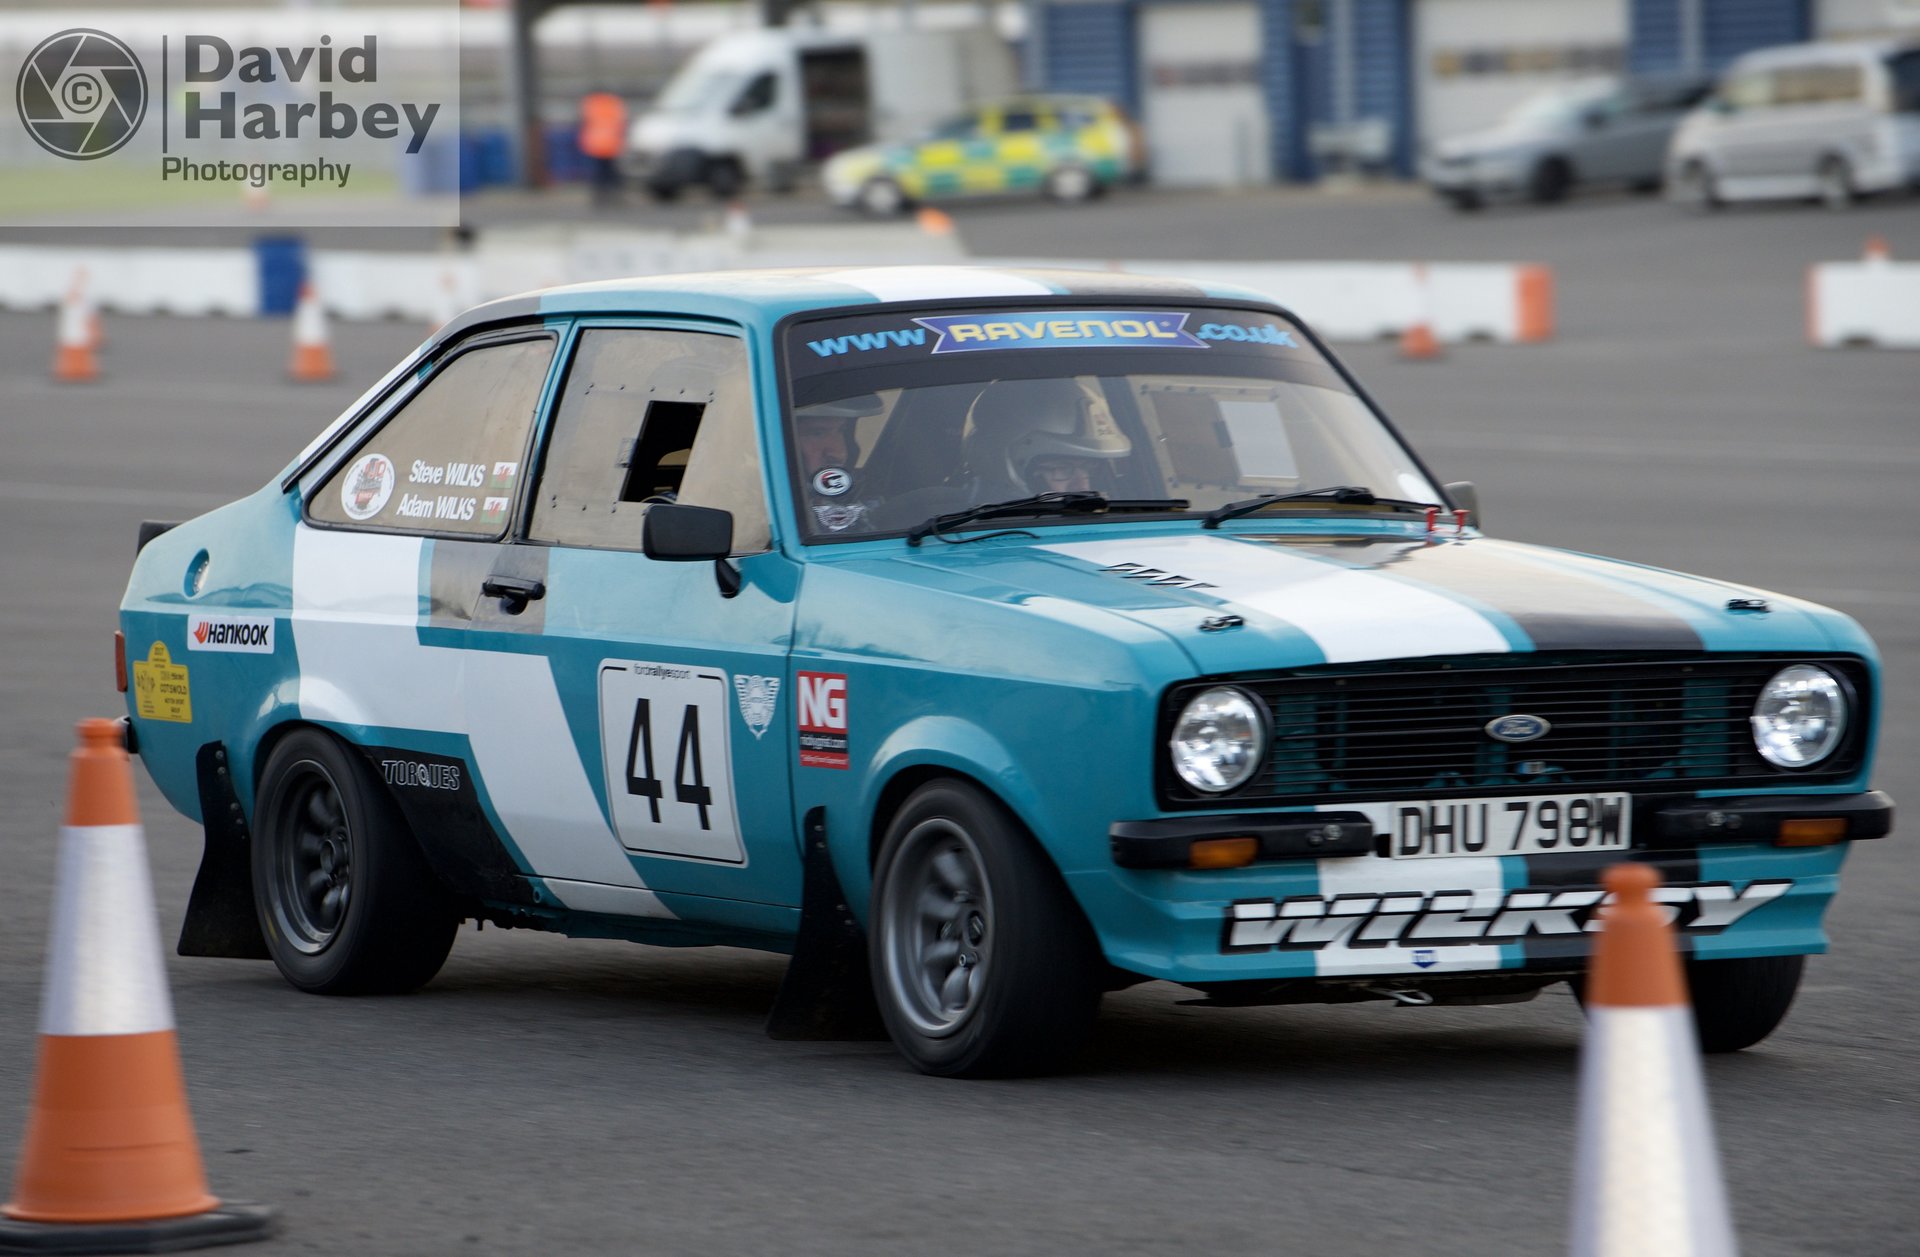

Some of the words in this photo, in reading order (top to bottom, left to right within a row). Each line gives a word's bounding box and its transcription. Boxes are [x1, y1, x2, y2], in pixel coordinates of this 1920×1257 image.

[408, 459, 441, 484] Steve
[444, 462, 486, 488] WILKS
[396, 493, 432, 518] Adam
[434, 495, 476, 521] WILKS
[798, 676, 847, 730] NG
[381, 760, 460, 791] TORQUES
[626, 697, 713, 831] 44
[1398, 803, 1489, 856] DHU
[1502, 796, 1624, 851] 798W
